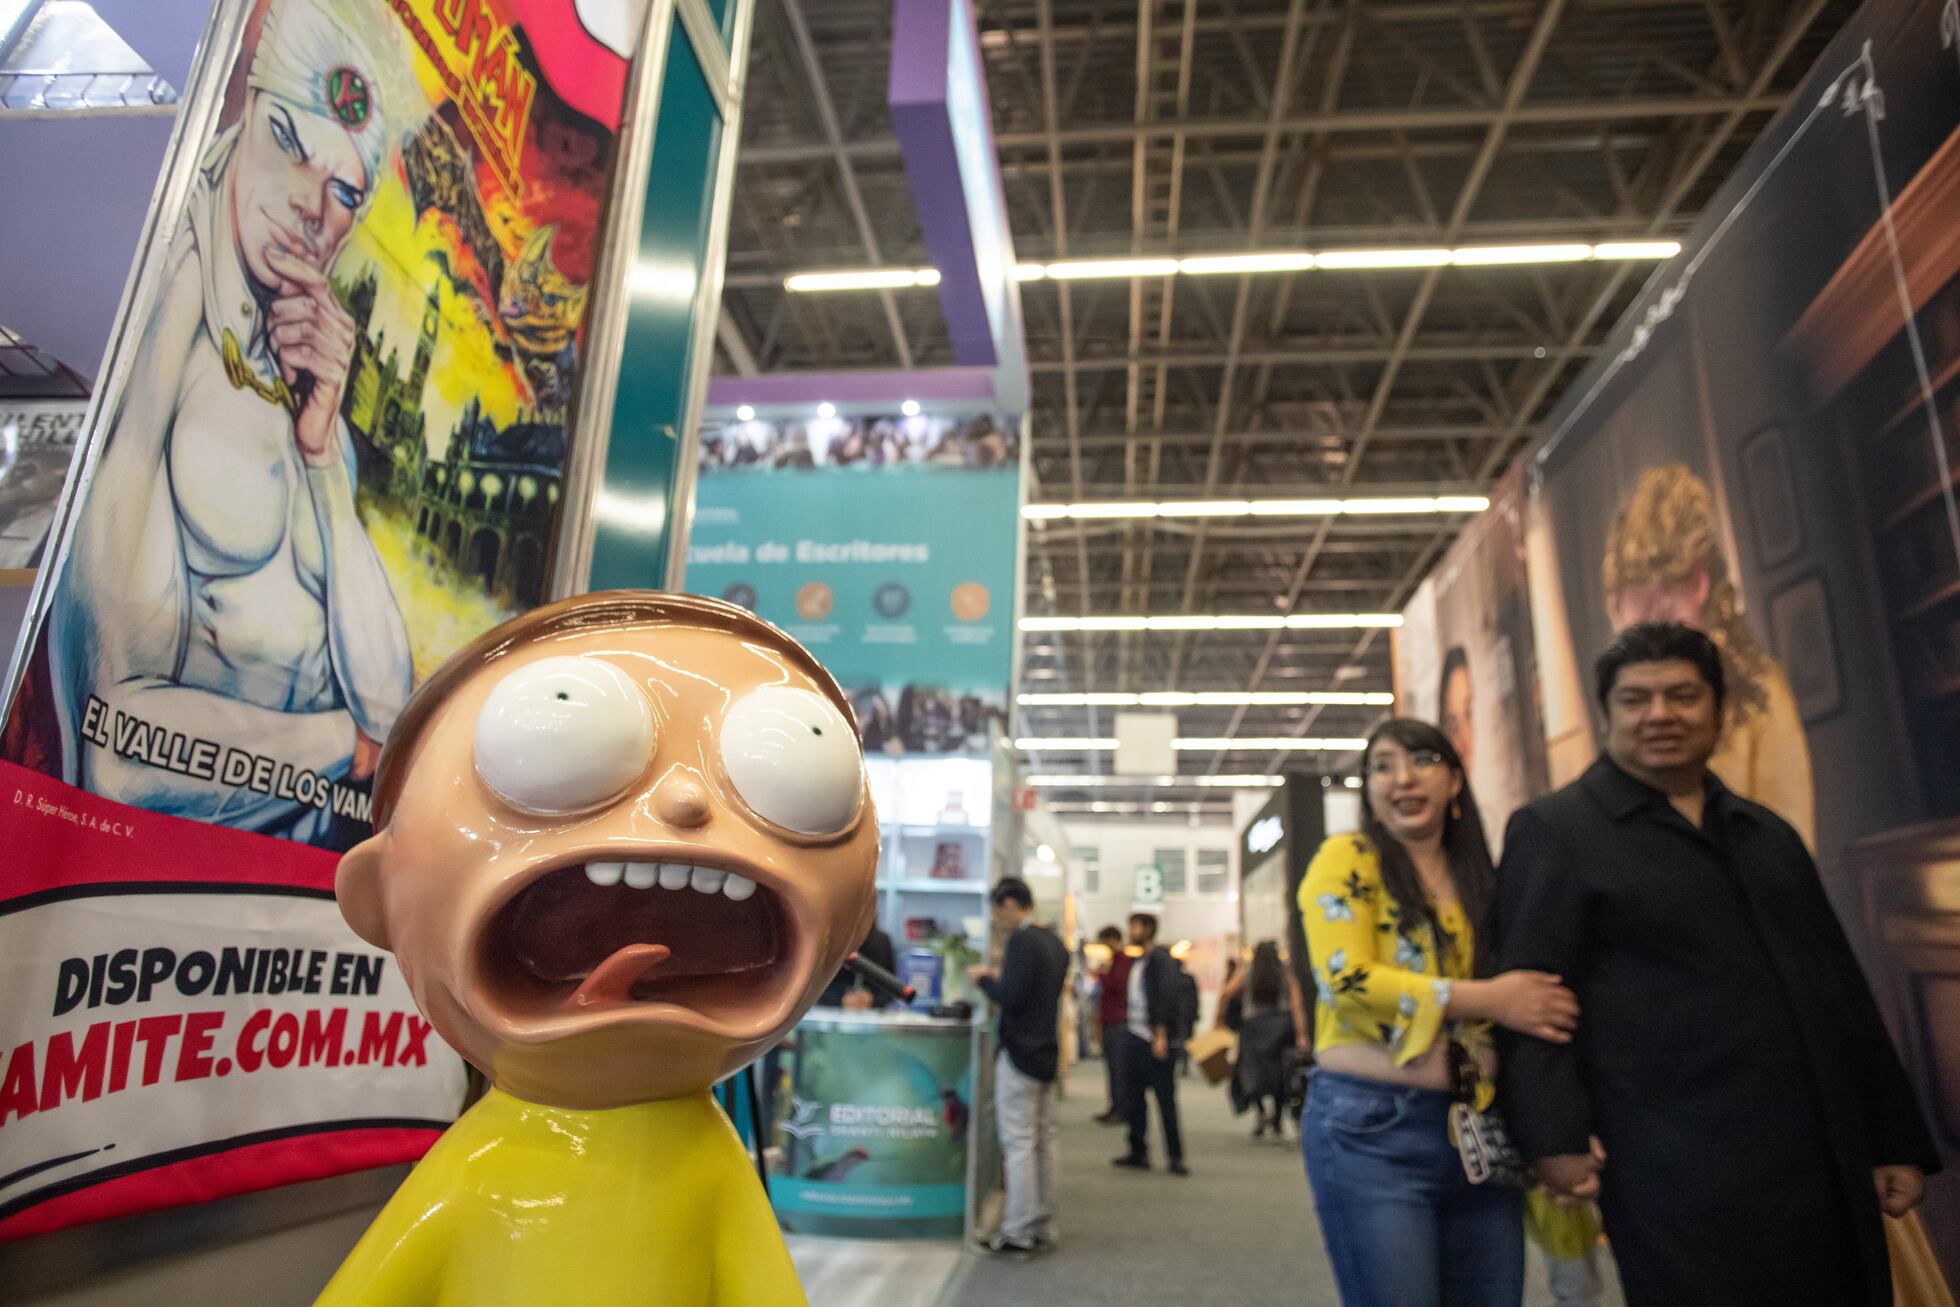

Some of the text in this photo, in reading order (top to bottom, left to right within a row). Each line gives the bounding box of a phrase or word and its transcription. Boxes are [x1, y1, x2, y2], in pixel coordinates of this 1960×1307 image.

[755, 540, 788, 563] de
[796, 539, 929, 563] Escritores
[81, 695, 109, 748] EL
[114, 711, 220, 782] VALLE
[221, 749, 275, 794] DE
[276, 764, 330, 809] LOS
[14, 790, 23, 805] D.
[26, 794, 34, 808] R.
[100, 819, 111, 833] de
[125, 824, 135, 839] V.
[1136, 867, 1161, 900] B
[53, 947, 385, 1017] DISPONIBLE EN
[0, 1008, 432, 1128] AMITE.COM.MX
[830, 1103, 937, 1127] EDITORIAL
